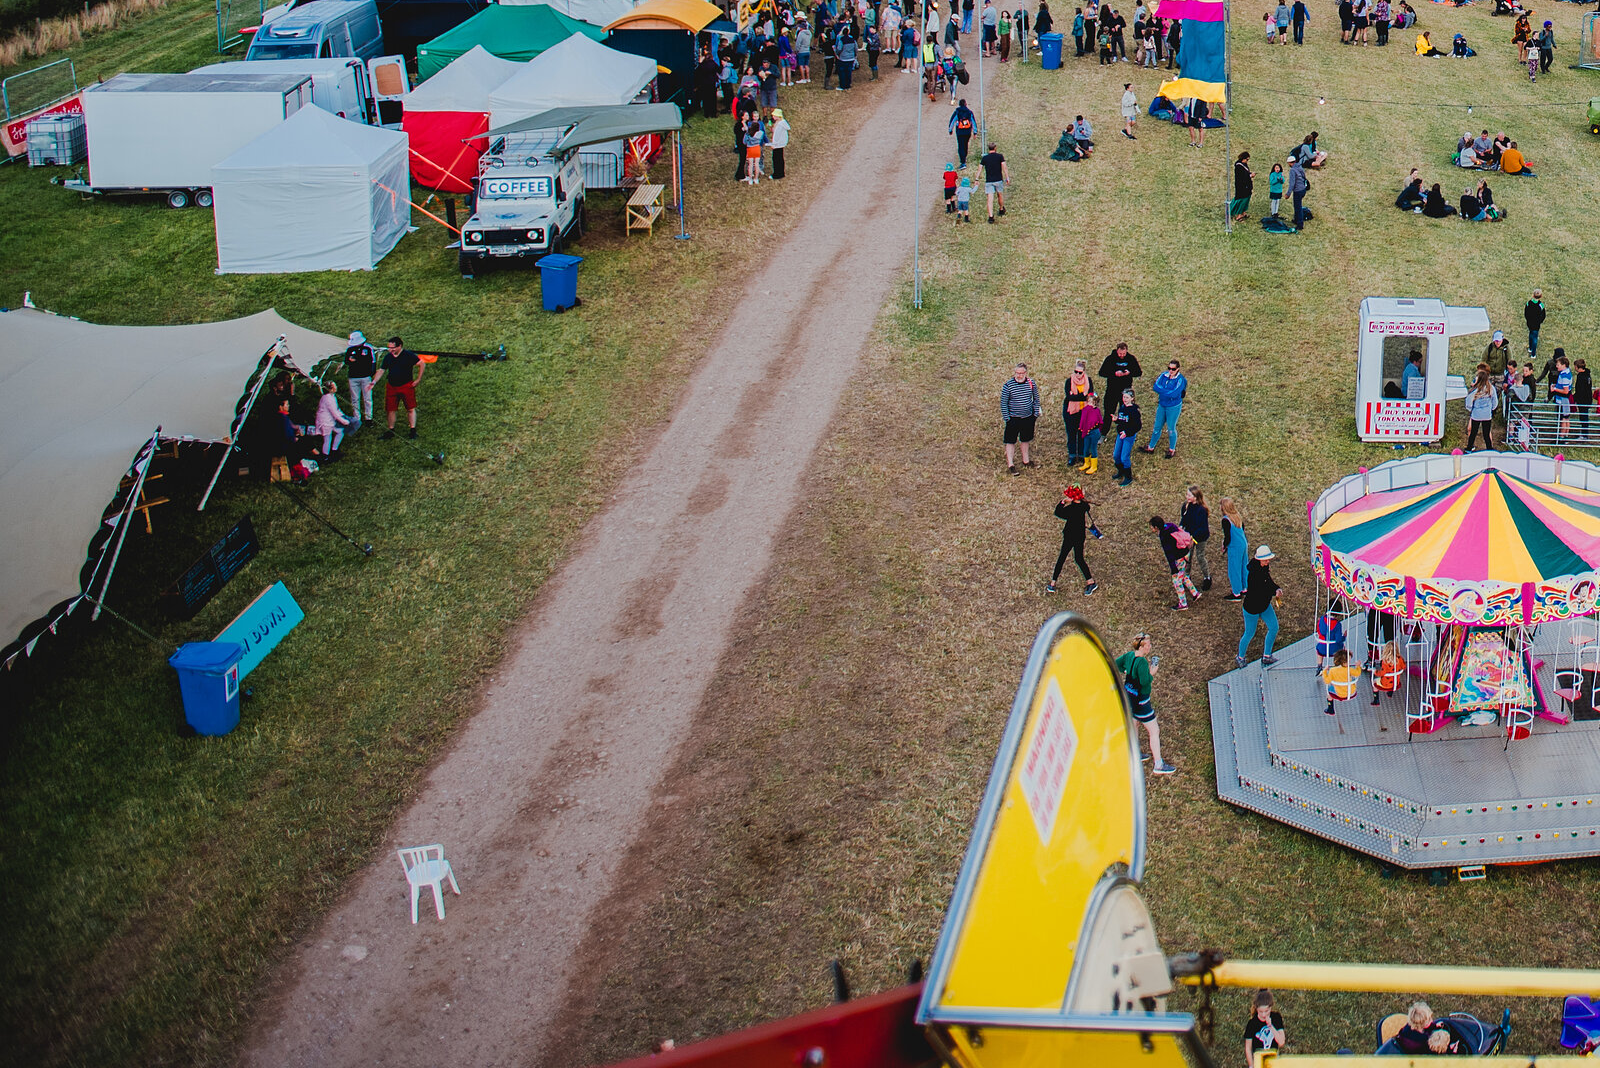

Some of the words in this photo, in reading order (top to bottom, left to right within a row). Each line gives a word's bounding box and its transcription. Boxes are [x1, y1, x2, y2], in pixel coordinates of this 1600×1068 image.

[488, 181, 545, 194] COFFEE
[252, 603, 287, 645] DOWN
[1025, 695, 1055, 778] WARNING
